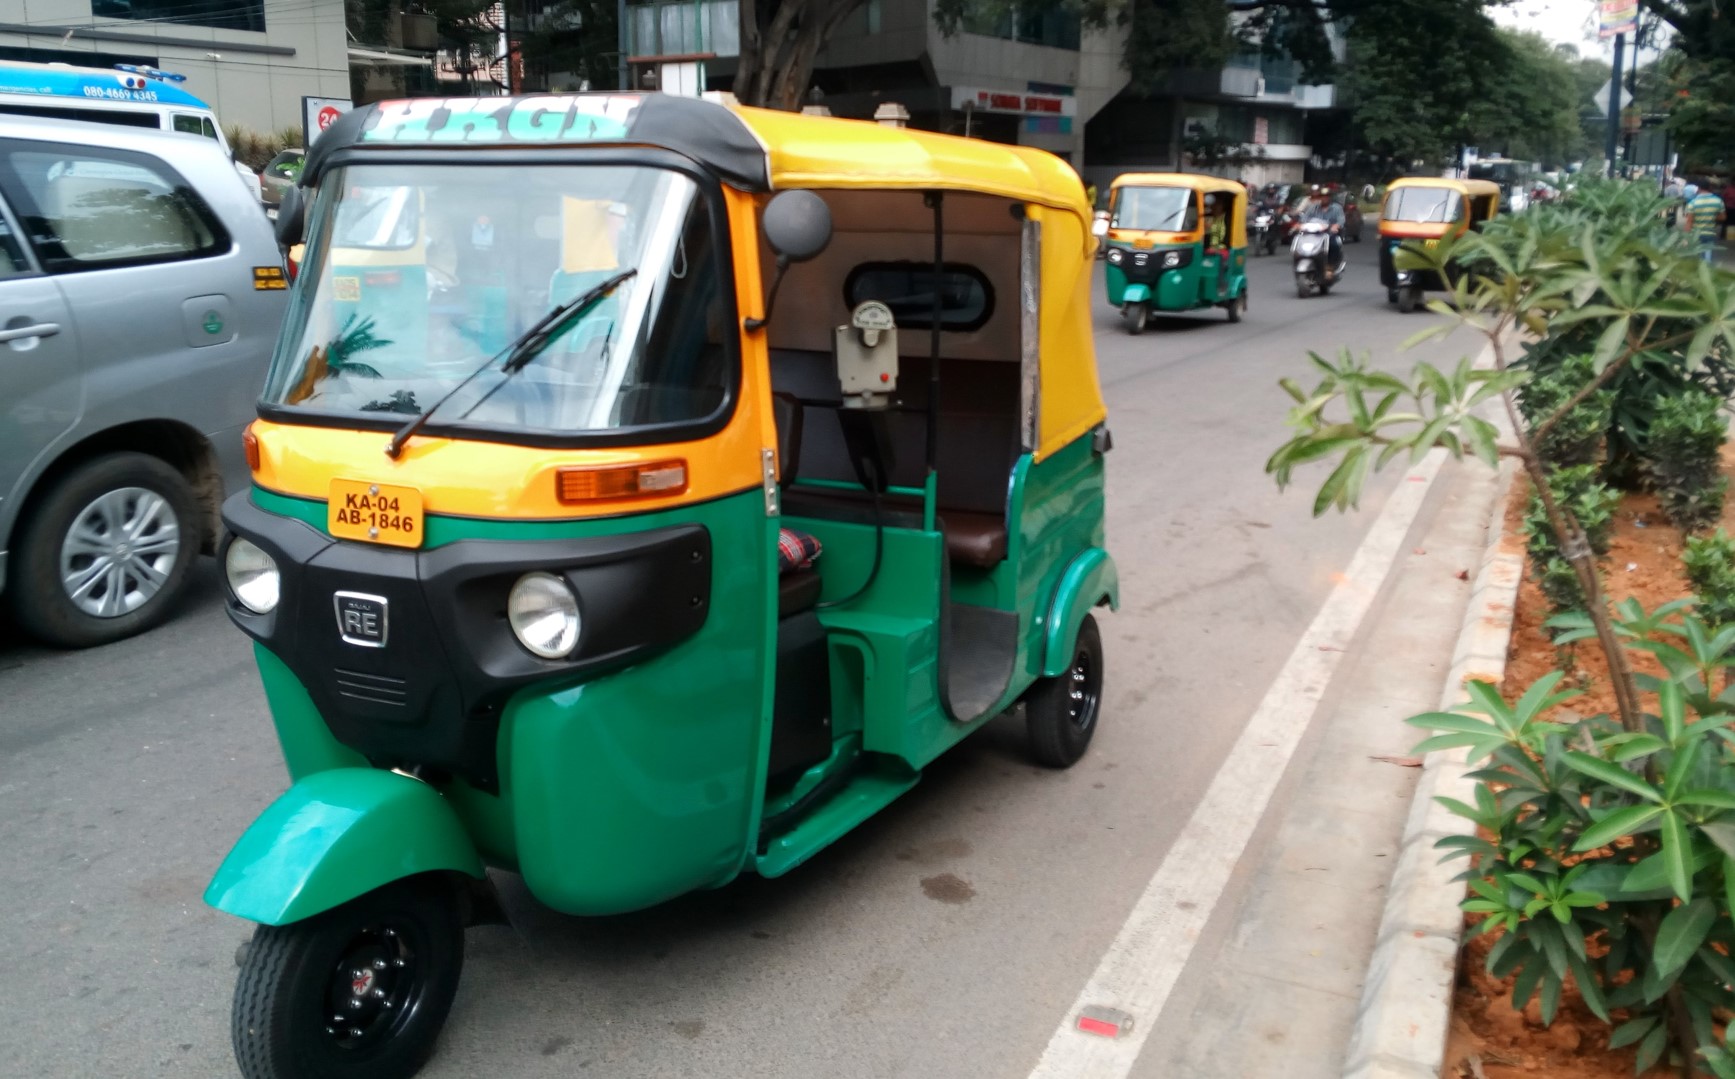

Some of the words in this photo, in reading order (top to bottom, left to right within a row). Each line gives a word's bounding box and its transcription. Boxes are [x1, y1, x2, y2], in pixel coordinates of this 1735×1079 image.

[133, 90, 158, 102] 4345
[346, 493, 400, 513] KA-04
[336, 508, 414, 533] AB-1846
[344, 609, 379, 637] RE
